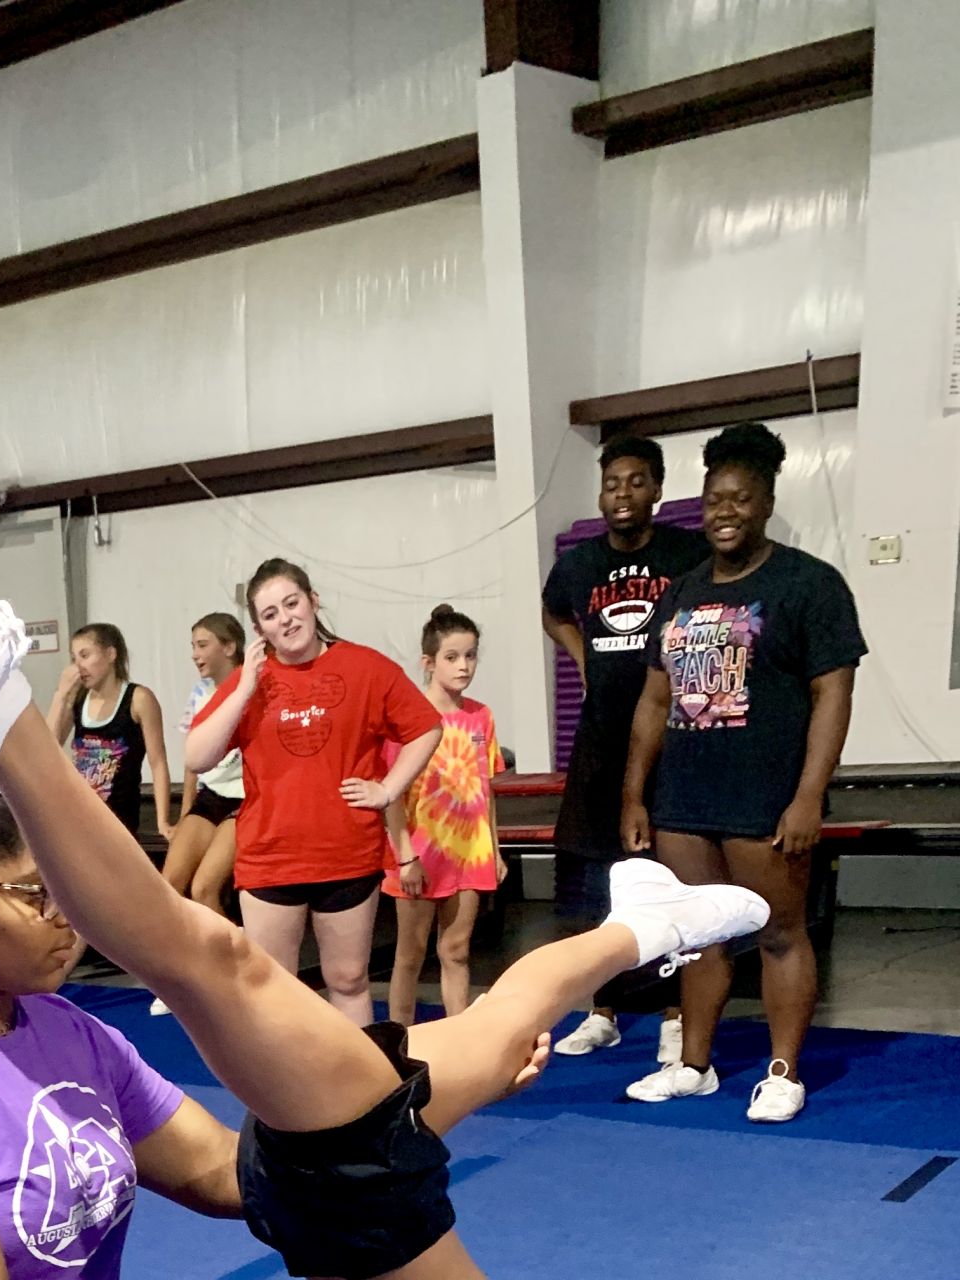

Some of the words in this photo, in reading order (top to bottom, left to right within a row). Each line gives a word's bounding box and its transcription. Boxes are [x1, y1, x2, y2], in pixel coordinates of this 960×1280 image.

[608, 565, 650, 582] CSRA
[591, 633, 649, 652] CHEERLEA
[668, 645, 748, 696] EACH
